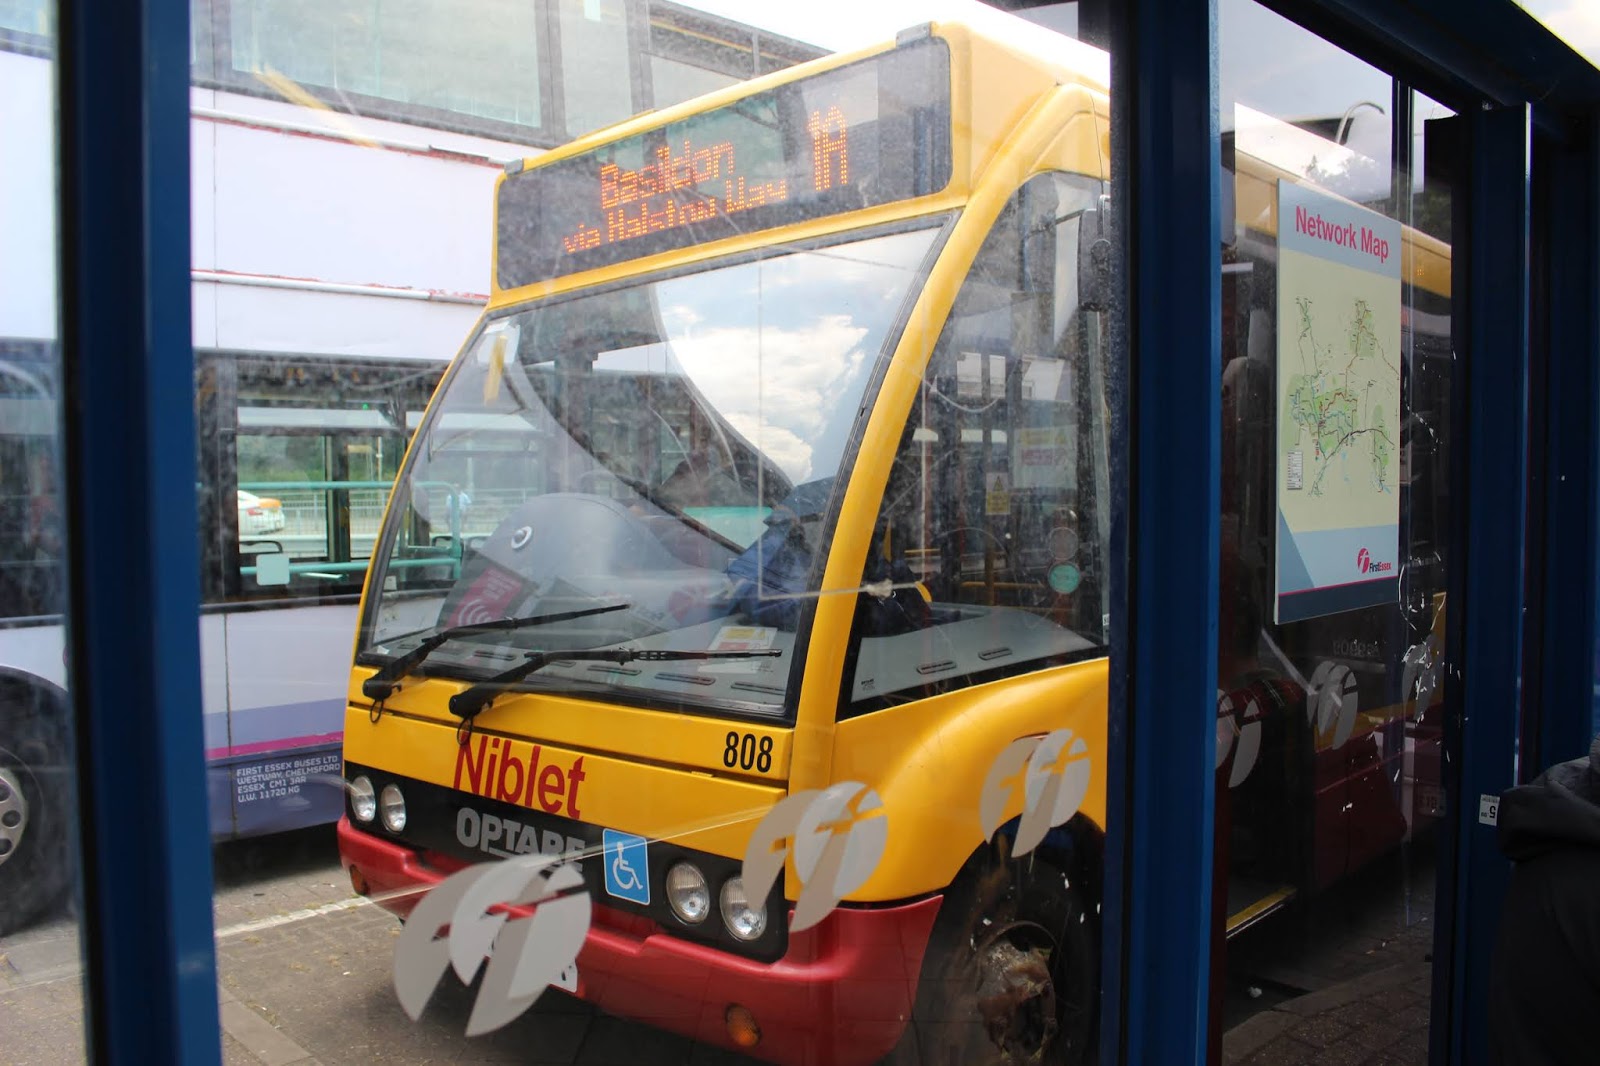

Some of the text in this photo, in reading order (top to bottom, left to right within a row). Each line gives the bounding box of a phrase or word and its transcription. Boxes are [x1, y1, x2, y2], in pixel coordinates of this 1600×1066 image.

[808, 104, 847, 192] 1A
[600, 140, 735, 209] Basildon
[563, 223, 602, 255] via
[1295, 205, 1389, 264] Network Map
[236, 756, 338, 777] FIRST ESSEX BUSES LTD
[285, 763, 341, 777] CHELMSFORD
[722, 730, 774, 774] 808
[238, 776, 307, 793] ESSEX CM1 3AR
[238, 785, 300, 803] U.W. 11720 KG
[453, 731, 586, 820] Niblet
[456, 807, 586, 872] OPTARE
